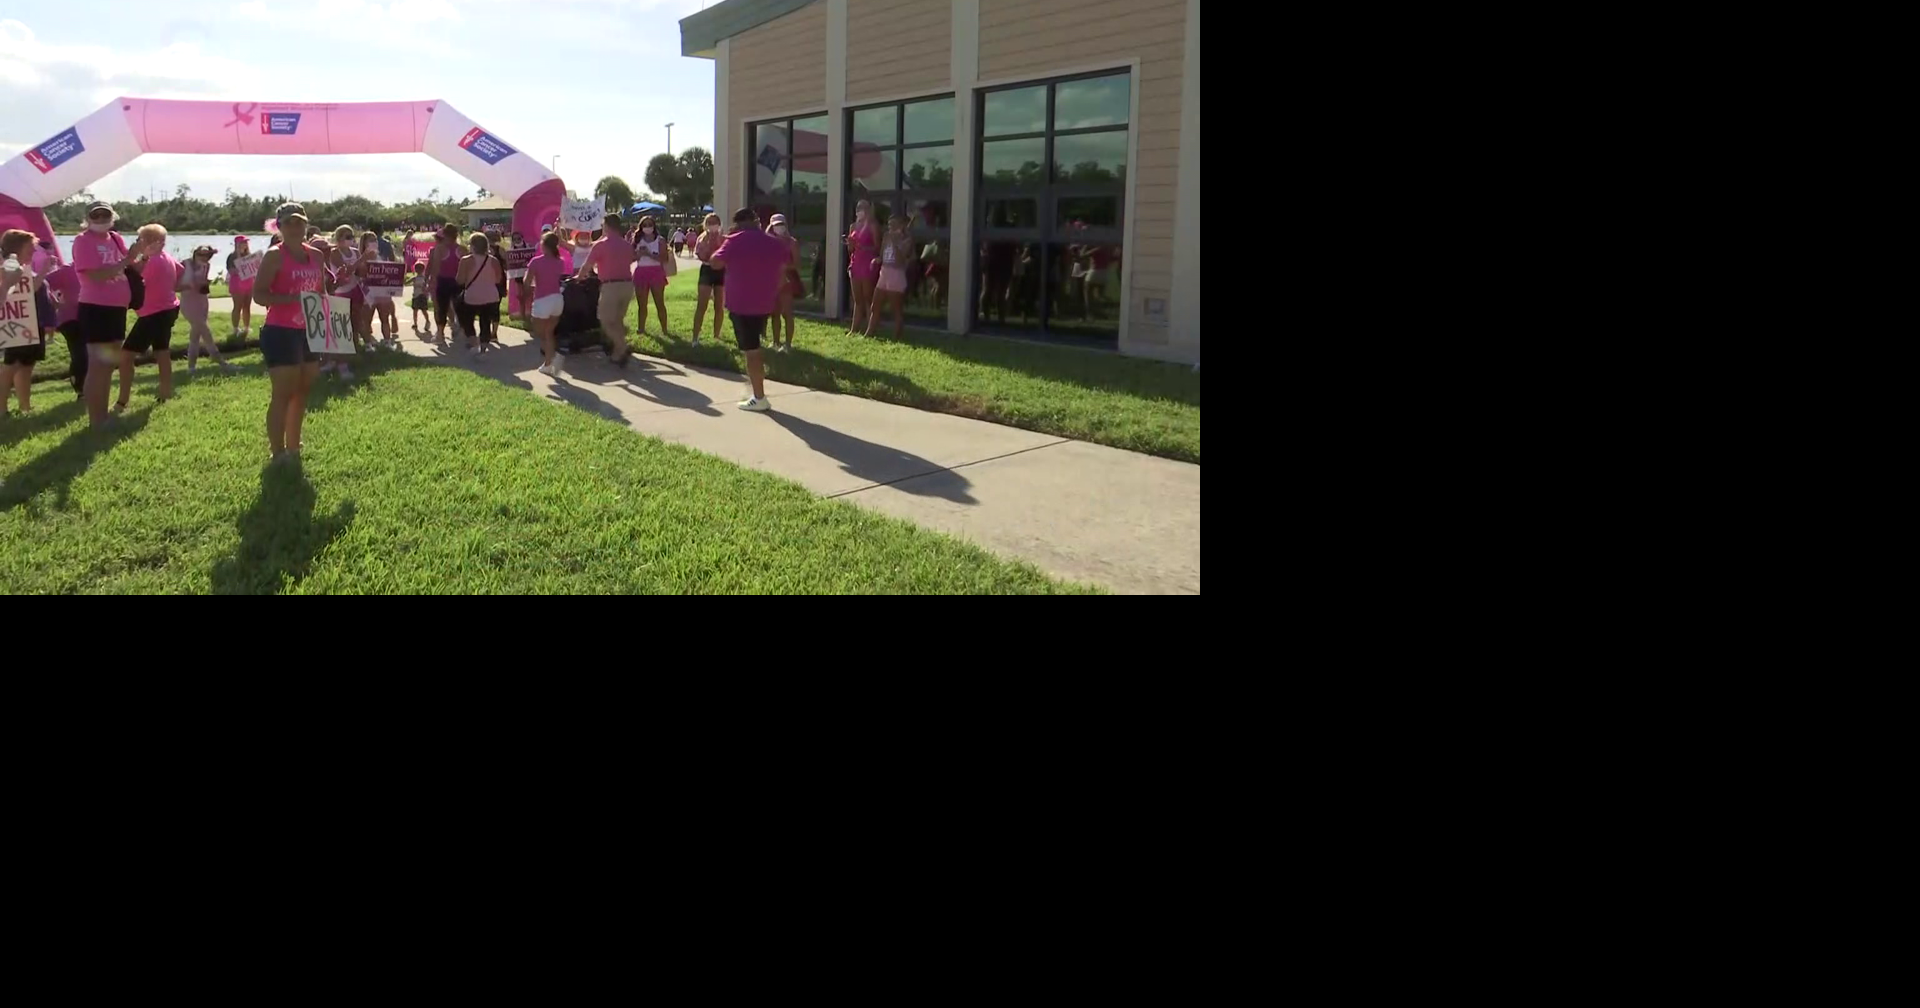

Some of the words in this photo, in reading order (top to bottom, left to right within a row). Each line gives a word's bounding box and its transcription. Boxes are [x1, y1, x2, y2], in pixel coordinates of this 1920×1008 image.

[41, 133, 73, 154] American
[44, 142, 67, 157] Cancer
[473, 142, 494, 158] Society
[477, 140, 498, 152] Cancer
[480, 136, 508, 154] American
[47, 145, 74, 161] Society
[369, 264, 380, 273] I'm
[381, 264, 399, 274] here
[303, 296, 352, 342] Believe
